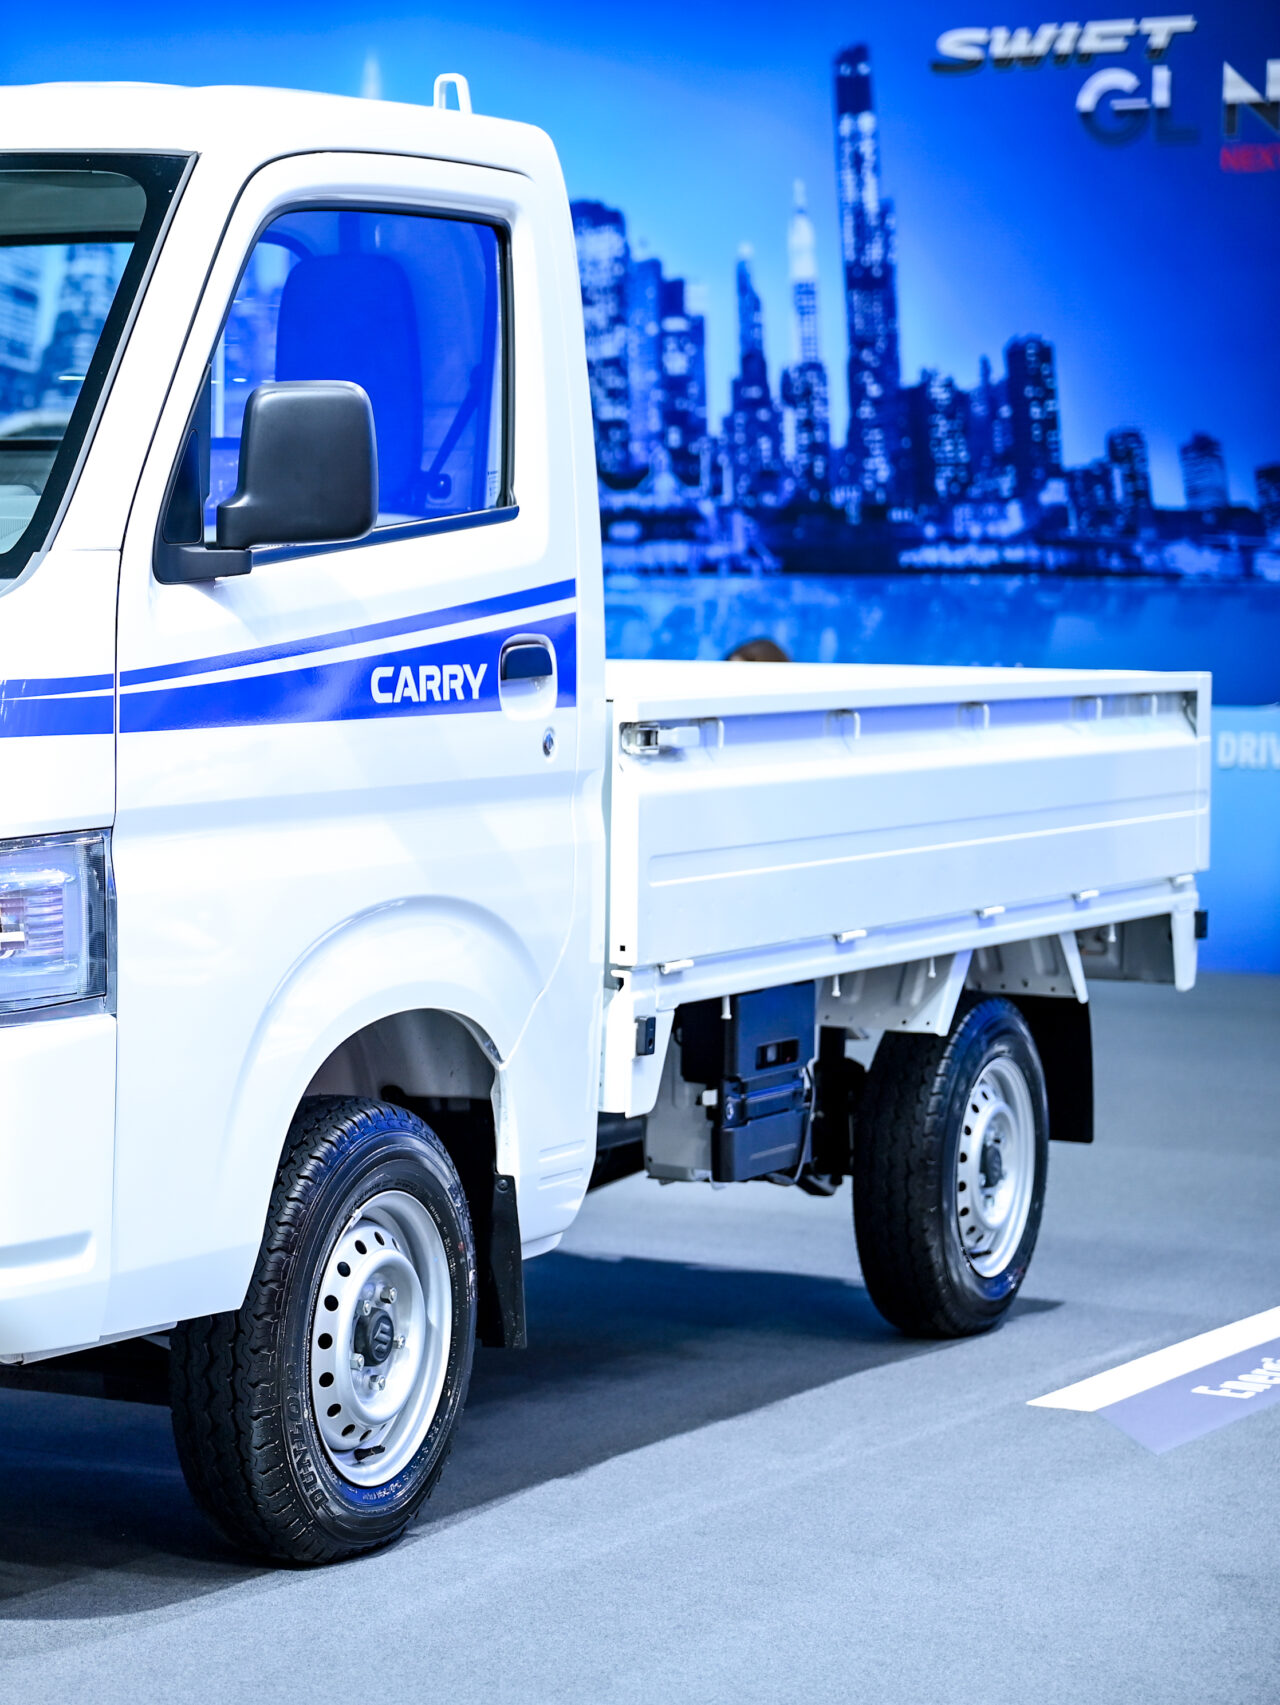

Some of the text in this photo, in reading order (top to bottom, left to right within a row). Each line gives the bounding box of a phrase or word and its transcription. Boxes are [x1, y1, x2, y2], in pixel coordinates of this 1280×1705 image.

[931, 14, 1198, 73] SWIFT
[1076, 65, 1200, 146] GL
[370, 663, 488, 704] CARRY
[285, 1362, 329, 1511] DUNLOP
